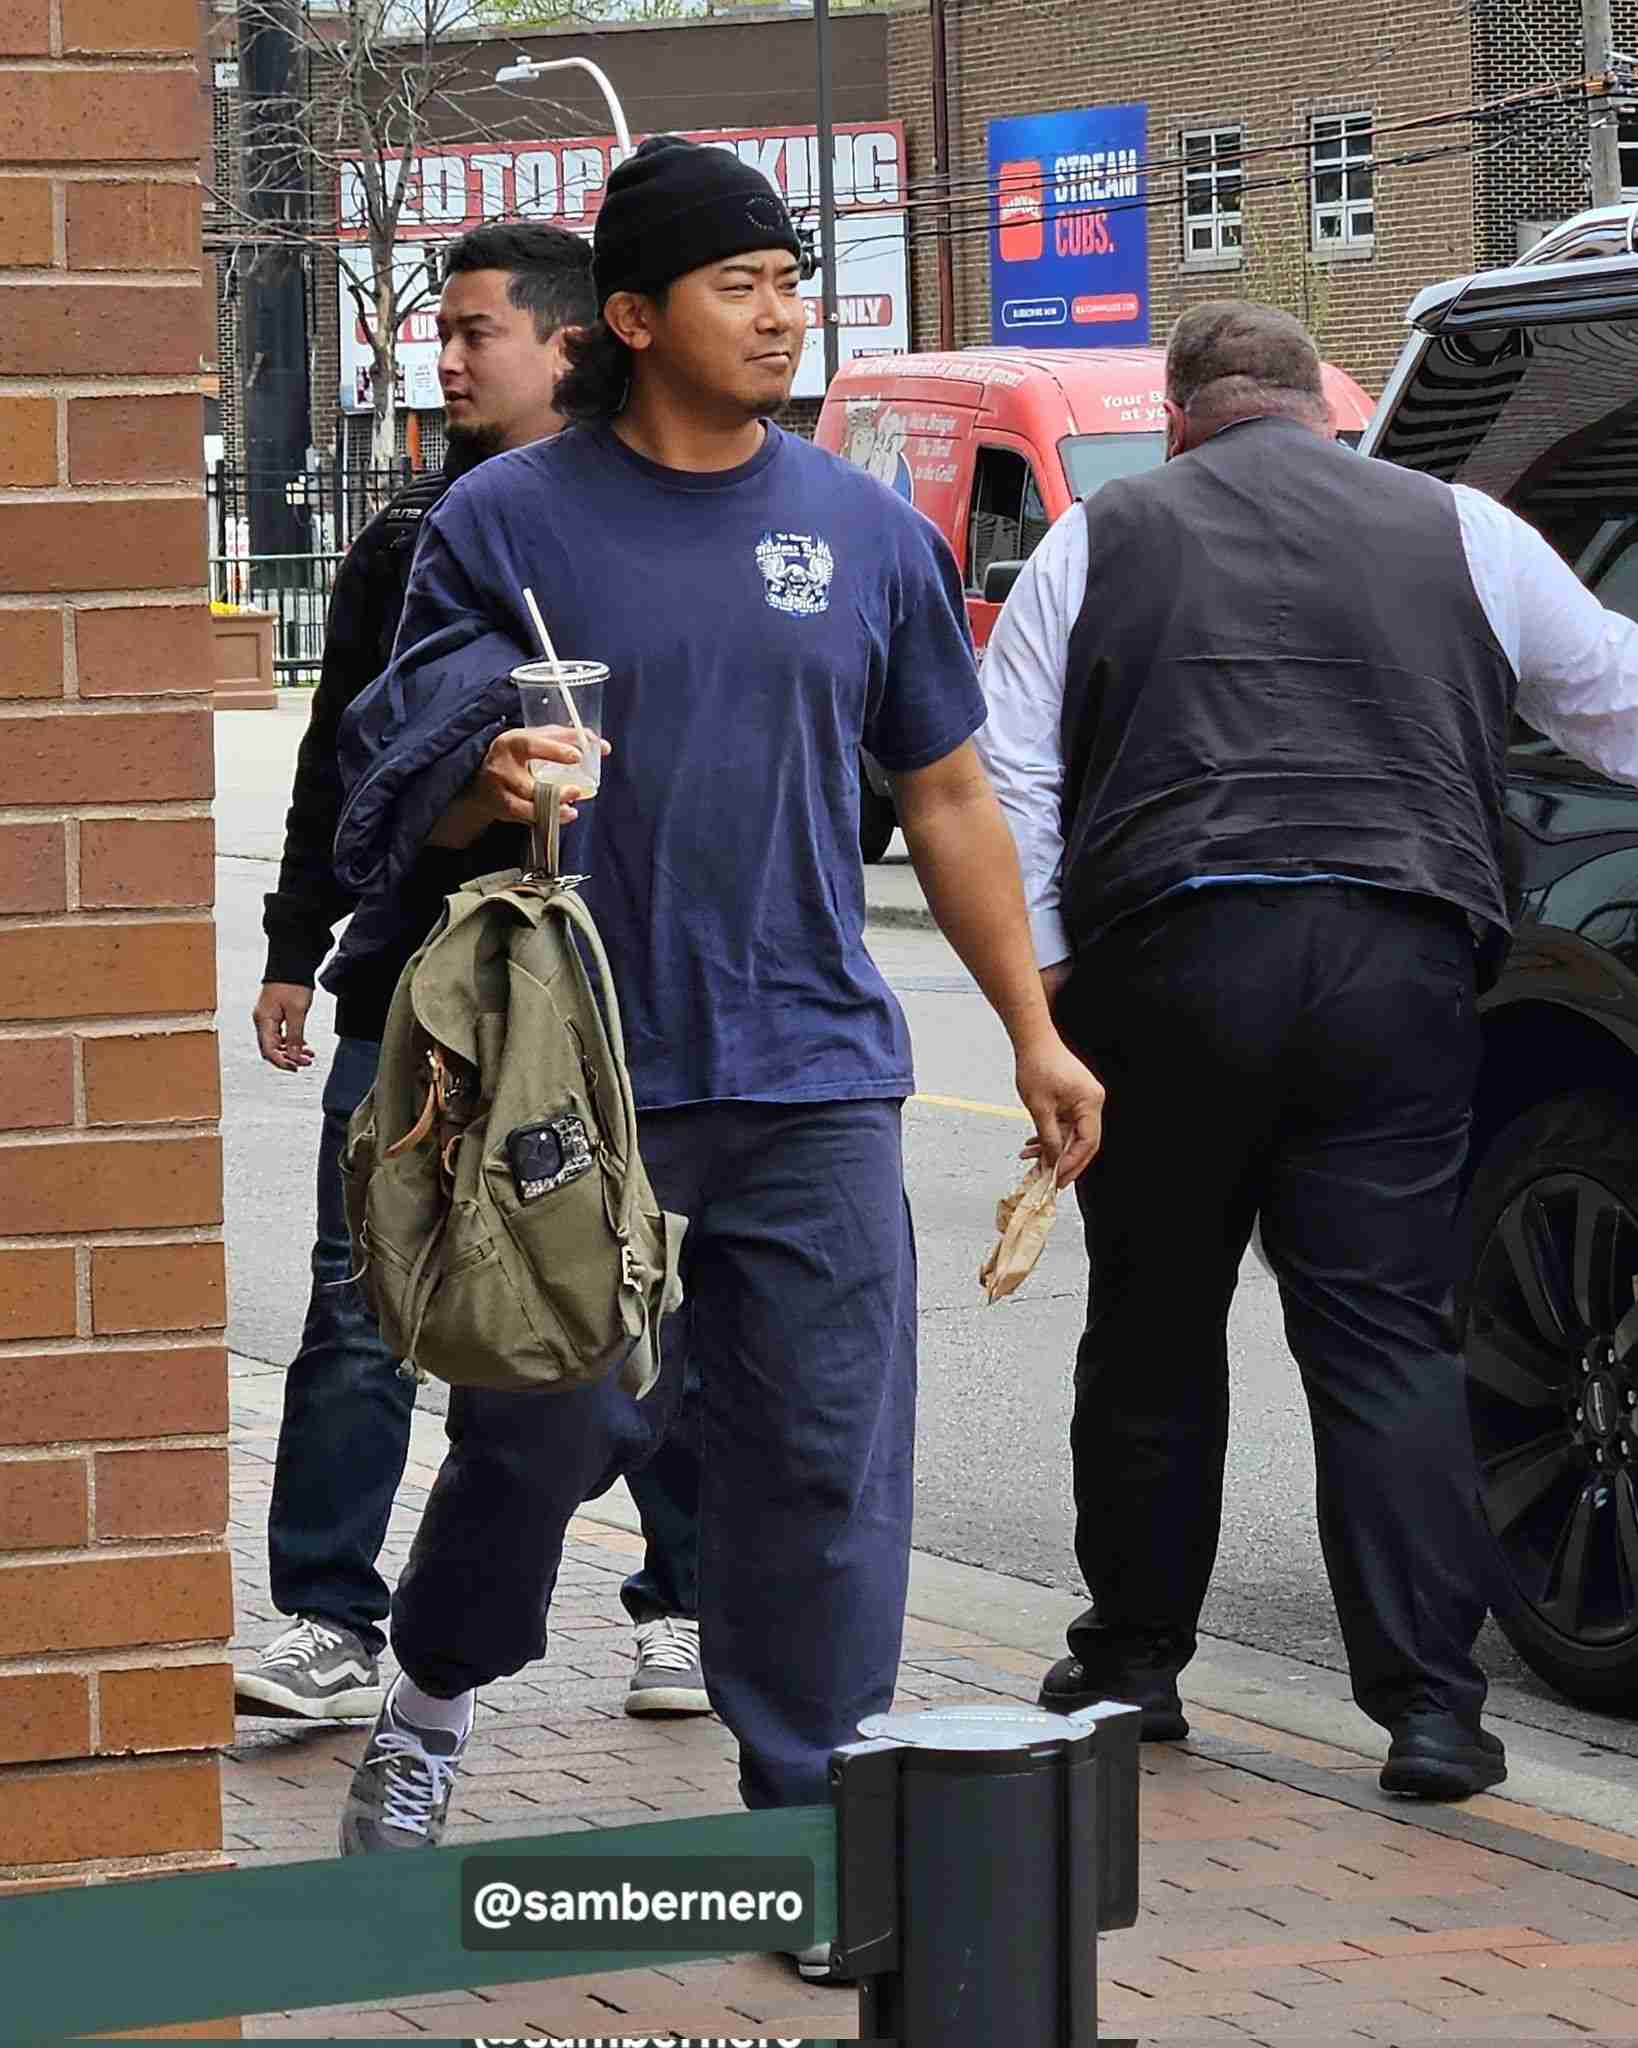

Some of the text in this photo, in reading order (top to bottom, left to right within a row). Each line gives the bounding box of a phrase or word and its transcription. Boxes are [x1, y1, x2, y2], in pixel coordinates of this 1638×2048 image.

[469, 147, 603, 222] TOP
[1054, 148, 1137, 204] STREAM
[837, 299, 883, 327] NLY
[1101, 394, 1144, 409] Your
[1120, 408, 1141, 422] at
